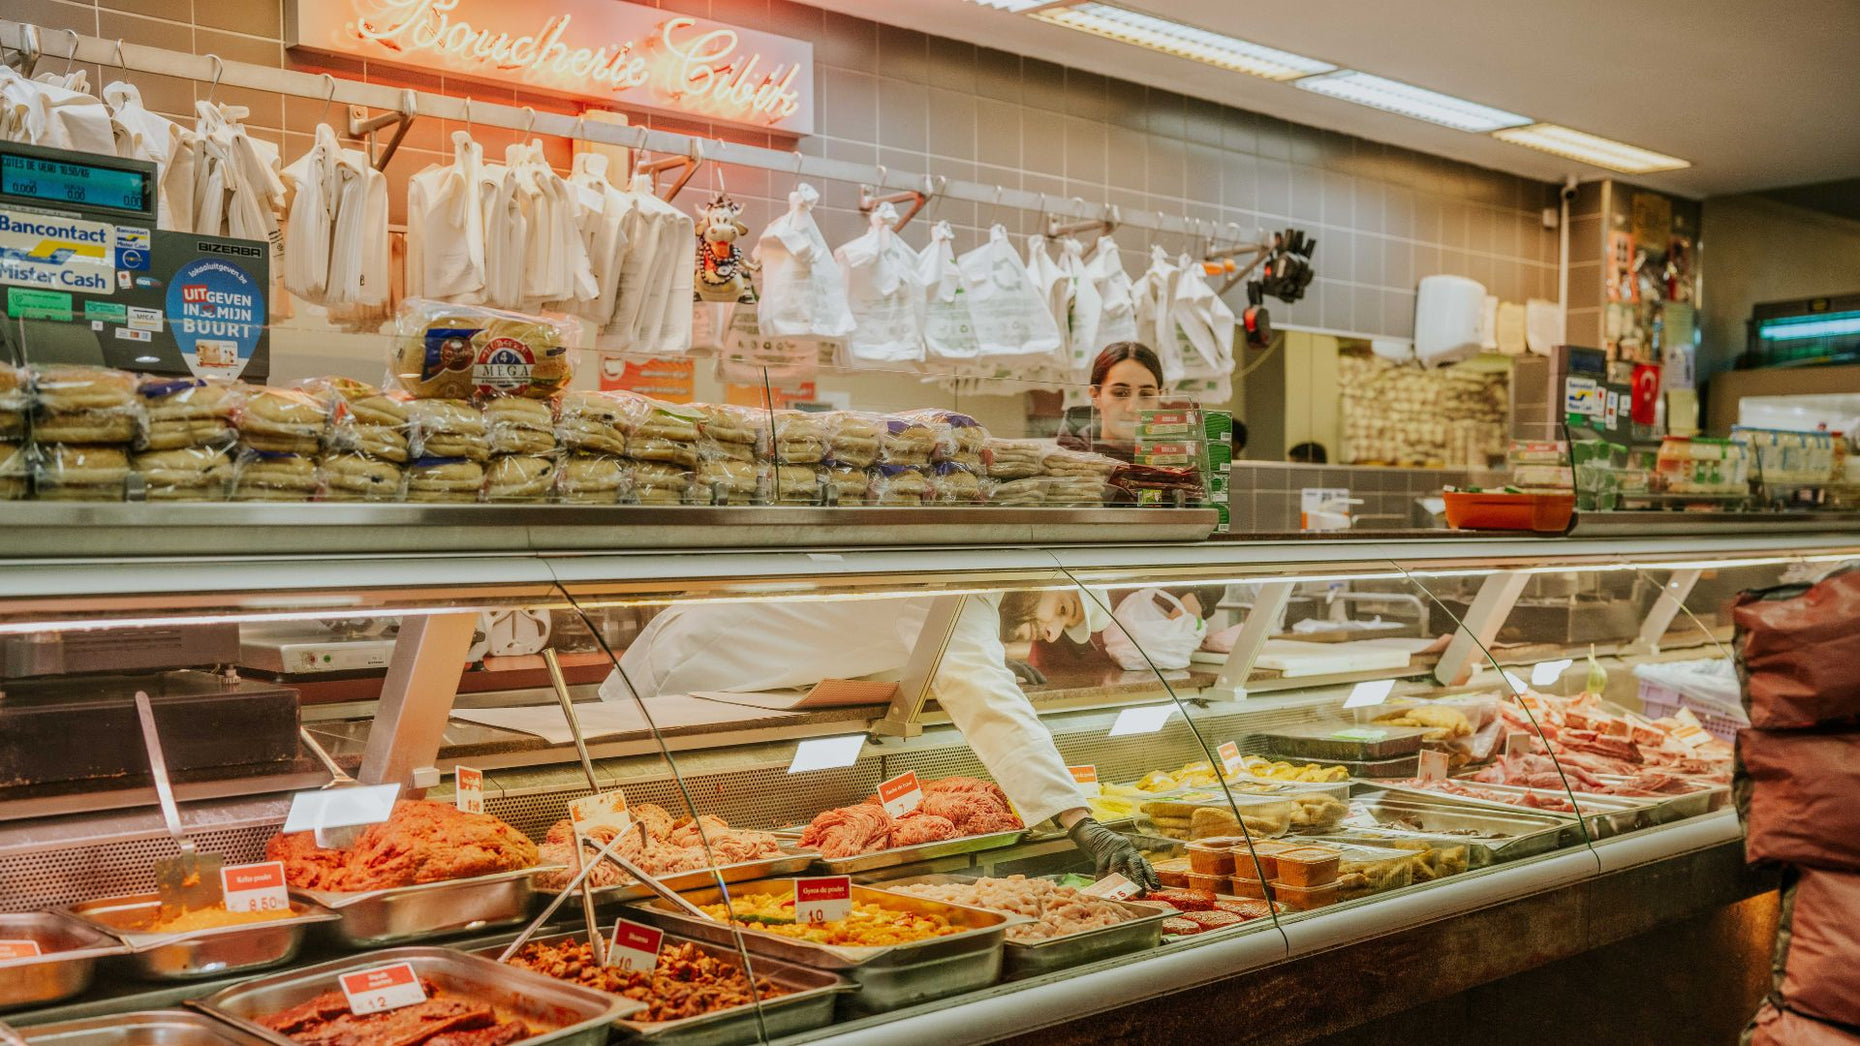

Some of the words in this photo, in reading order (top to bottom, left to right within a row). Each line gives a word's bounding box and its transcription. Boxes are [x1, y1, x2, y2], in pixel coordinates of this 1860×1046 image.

[357, 0, 650, 88] Boucherie
[0, 215, 106, 243] Bancontact
[198, 242, 261, 257] BIZERBA
[0, 262, 56, 284] Mister
[61, 269, 106, 289] Cash
[183, 287, 252, 307] UITGEVEN
[183, 303, 200, 316] IN
[217, 306, 252, 321] MIJN
[183, 318, 251, 338] BUURT
[482, 365, 529, 377] MEGA
[828, 885, 845, 894] poulet
